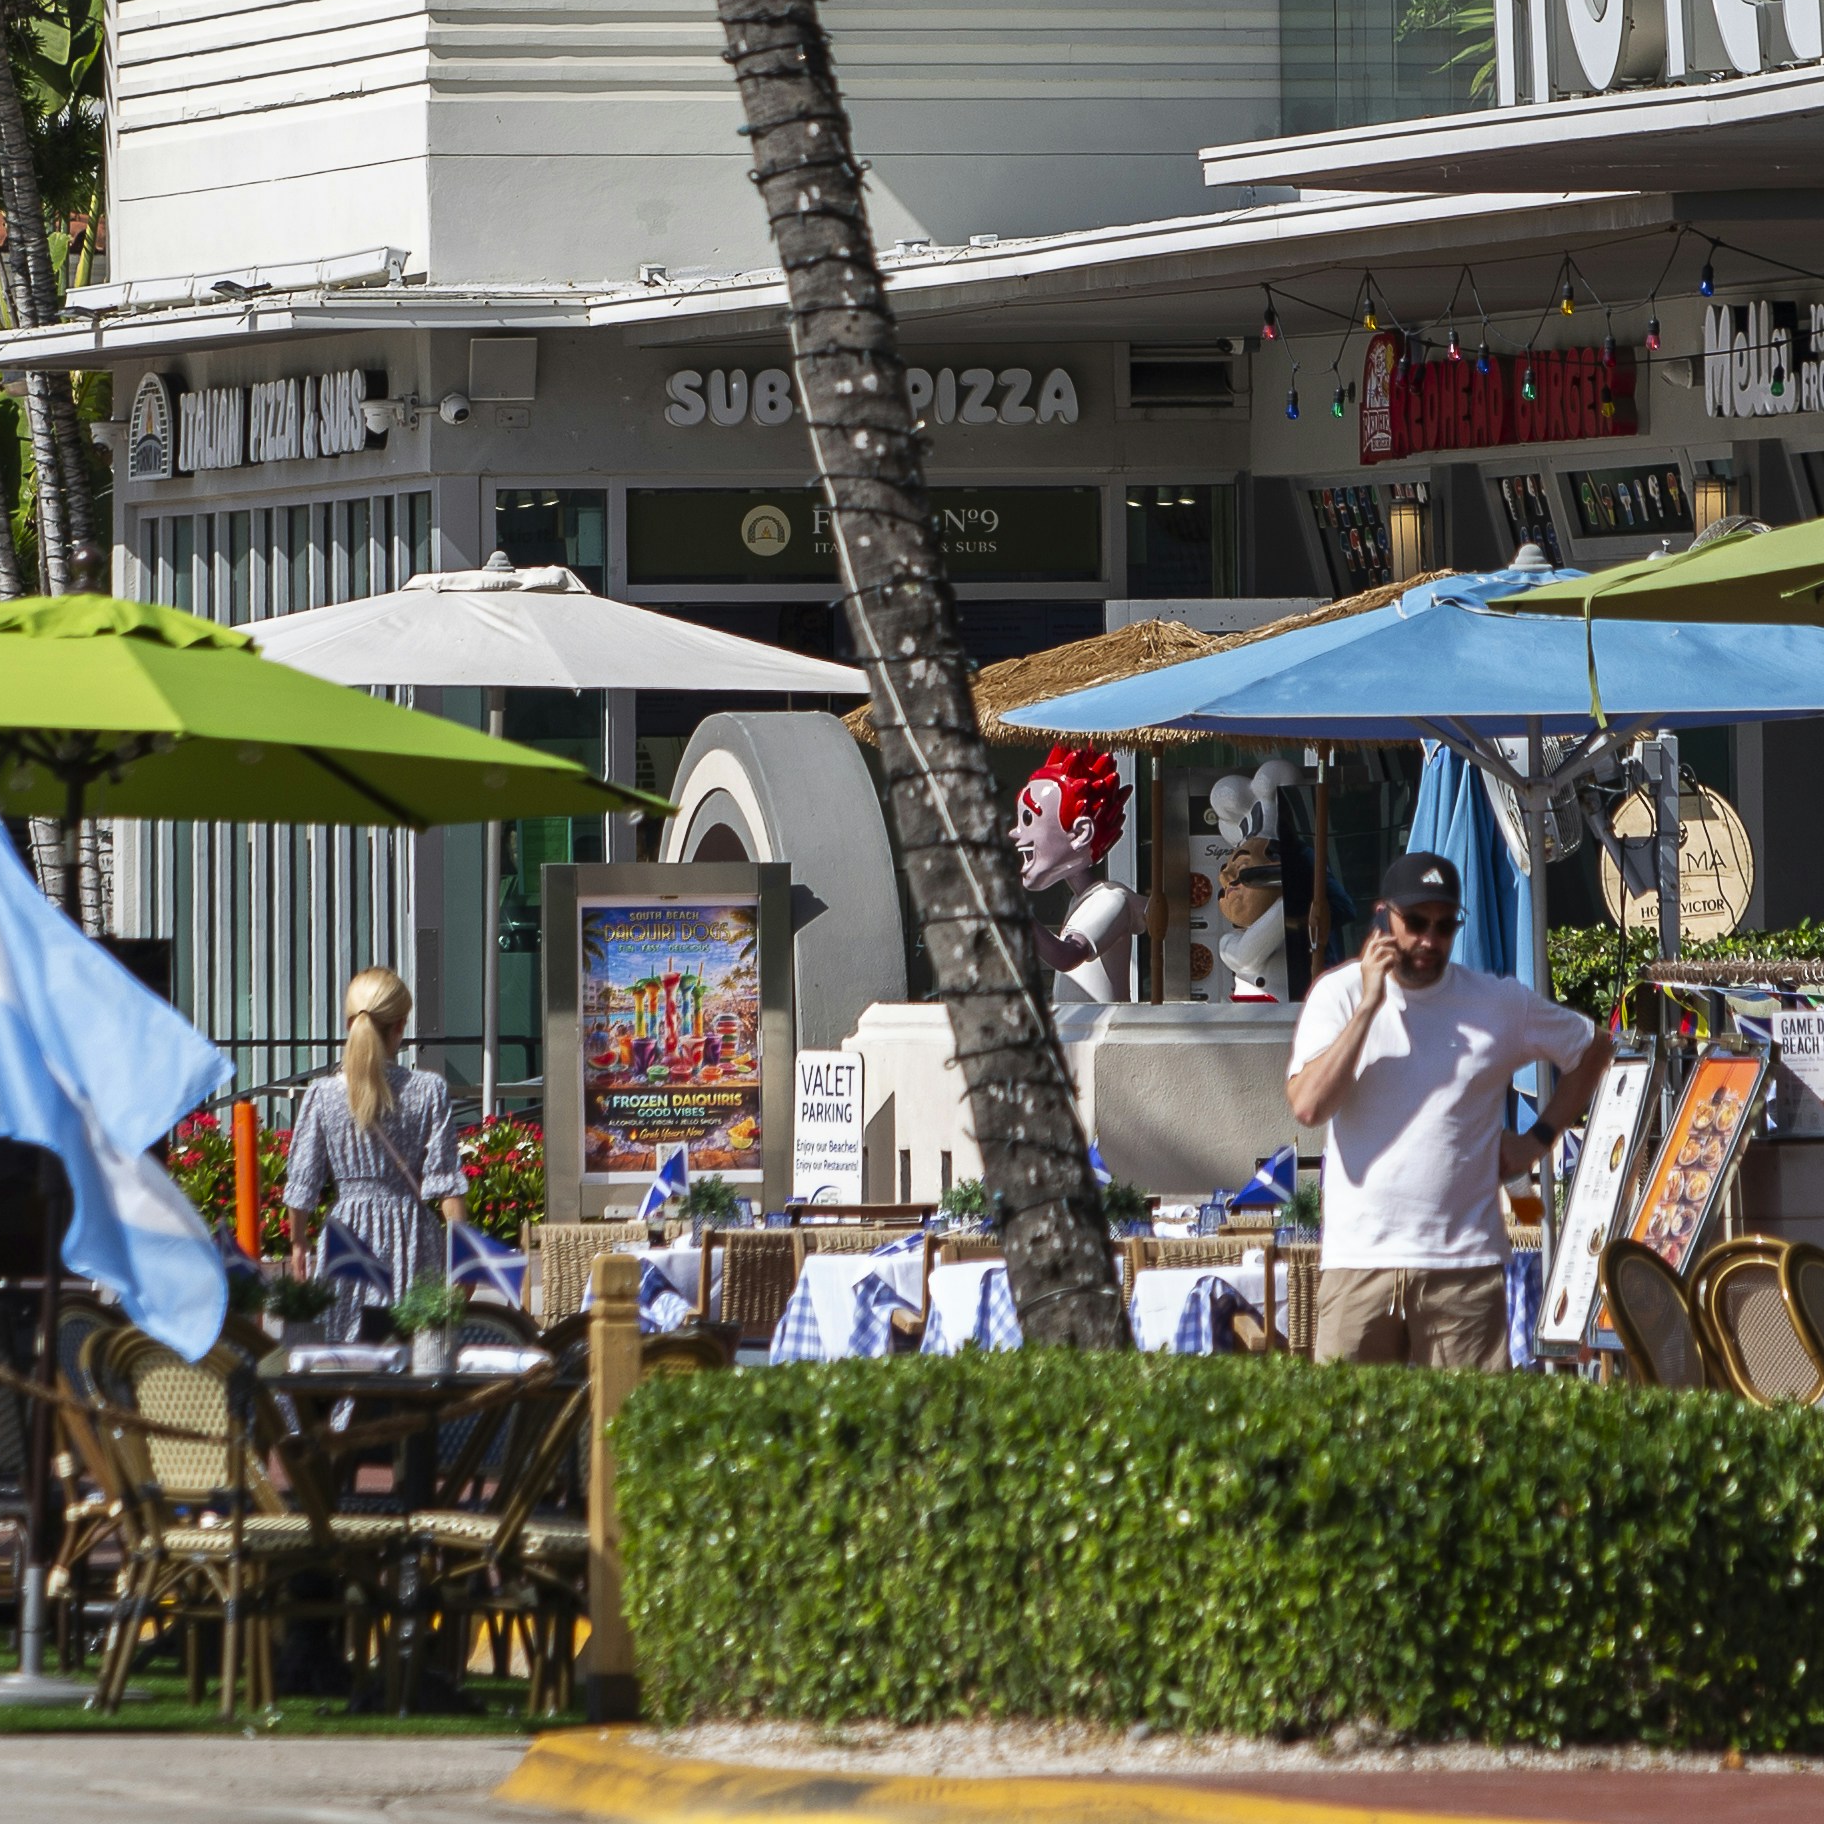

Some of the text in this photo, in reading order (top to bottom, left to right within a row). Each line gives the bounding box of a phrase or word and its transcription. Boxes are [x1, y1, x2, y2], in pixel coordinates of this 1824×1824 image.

[664, 367, 1079, 428] SUB PIZZA
[1390, 346, 1616, 454] REDHEAD BURGER
[178, 369, 366, 471] ITALIAN PIZZA & SUBS
[956, 541, 997, 553] SUBS
[1681, 898, 1725, 914] VICTOR
[629, 911, 699, 922] SOUTH BEACH
[603, 921, 731, 943] DAIQUIRI DOGS
[1781, 1018, 1814, 1036] GAME
[1782, 1036, 1820, 1055] BEACH
[801, 1064, 855, 1097] VALET
[613, 1093, 743, 1108] FROZEN DAIQUIRIS
[637, 1107, 705, 1118] GOOD VIBES
[802, 1102, 852, 1123] PARKING
[796, 1139, 858, 1156] Enjoy our Beaches!
[796, 1158, 858, 1173] Enjoy our Restaurants!
